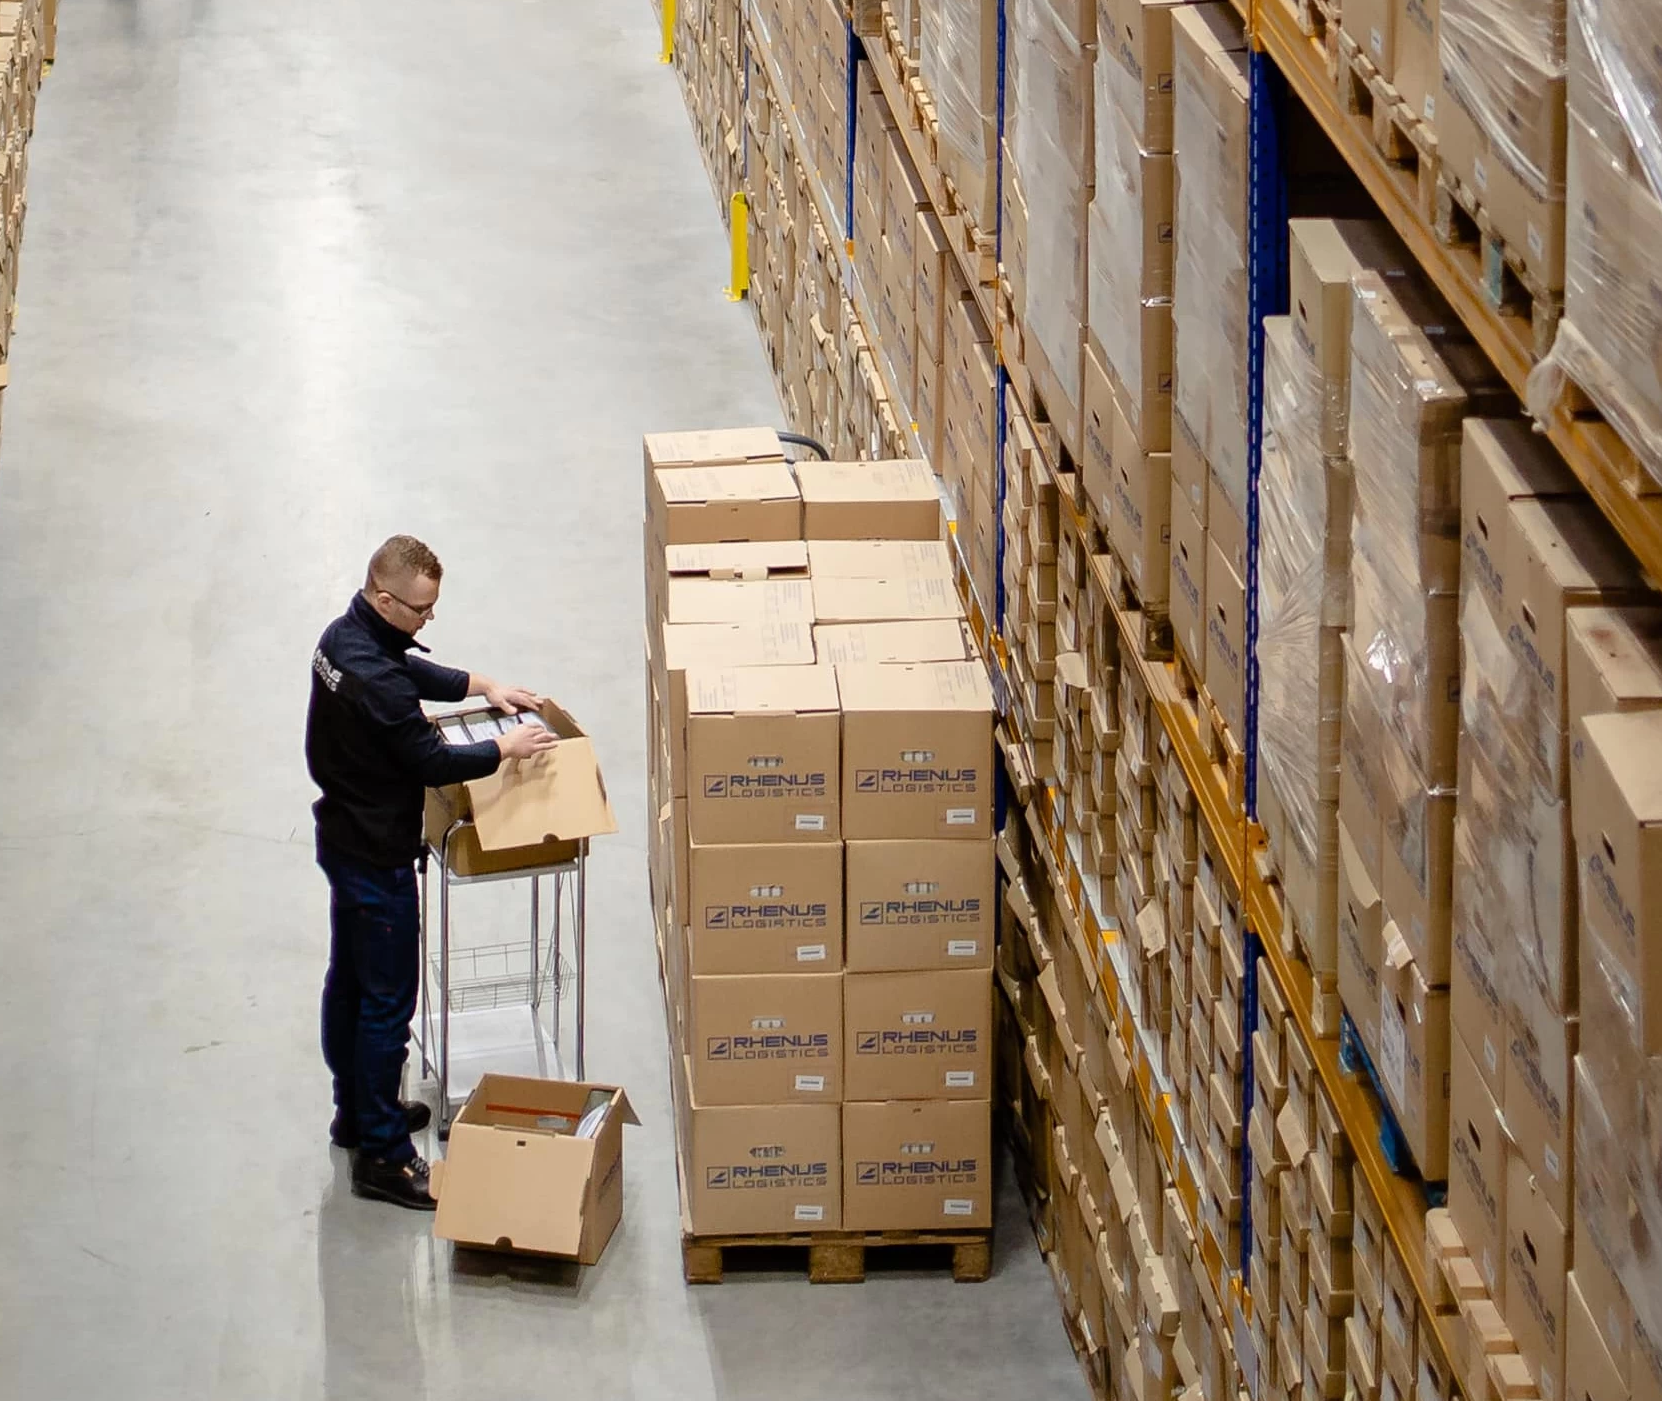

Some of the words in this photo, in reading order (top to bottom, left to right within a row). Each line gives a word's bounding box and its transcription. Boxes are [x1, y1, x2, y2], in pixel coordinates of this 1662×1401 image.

[730, 773, 825, 787] RHENUS
[882, 769, 977, 783] RHENUS
[730, 785, 825, 798] LOGISTICS
[882, 780, 977, 793] LOGISTICS
[731, 903, 827, 918] RHENUS
[886, 899, 980, 914] RHENUS
[731, 916, 827, 929] LOGISTICS
[886, 912, 980, 925] LOGISTICS
[733, 1034, 828, 1049] RHENUS
[882, 1030, 977, 1044] RHENUS
[733, 1047, 829, 1060] LOGISTICS
[882, 1041, 977, 1055] LOGISTICS
[733, 1162, 828, 1177] RHENUS
[882, 1159, 977, 1174] RHENUS
[733, 1175, 828, 1189] LOGISTICS
[882, 1172, 977, 1186] LOGISTICS
